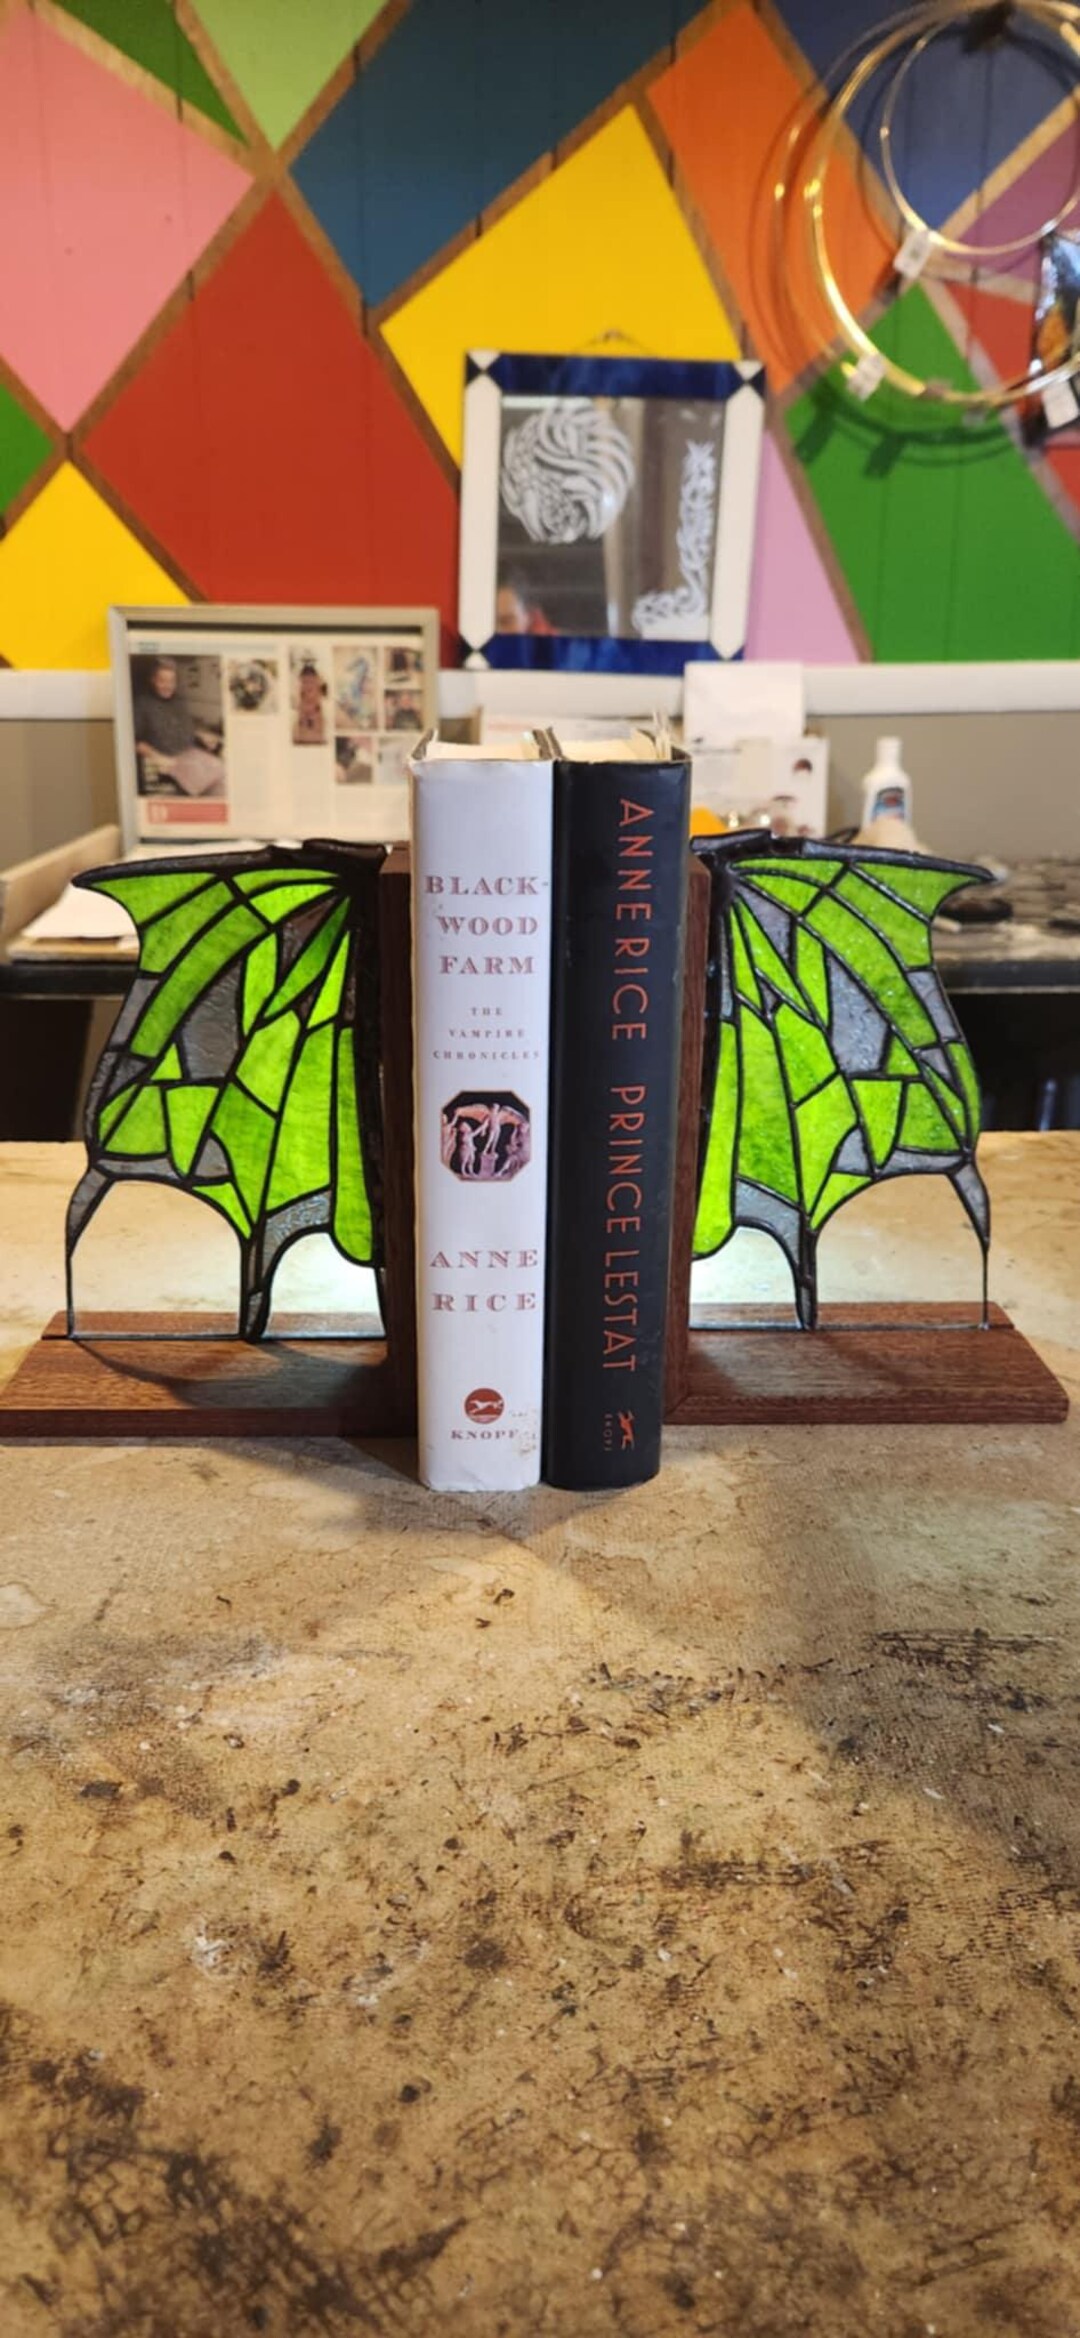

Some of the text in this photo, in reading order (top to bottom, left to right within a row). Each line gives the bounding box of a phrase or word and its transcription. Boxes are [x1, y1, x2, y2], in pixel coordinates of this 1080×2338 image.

[424, 875, 549, 896] BLACK-
[437, 916, 539, 936] WOOD
[612, 799, 654, 1040] ANNE RICE
[439, 955, 535, 975] FARM
[471, 1006, 503, 1017] THE
[449, 1028, 526, 1039] VAMPIRE
[432, 1050, 541, 1060] CHRONICLES
[602, 1084, 647, 1372] PRINCE LESTAT
[430, 1250, 539, 1269] ANNE
[432, 1292, 537, 1312] RICE
[450, 1428, 519, 1440] KNOPF
